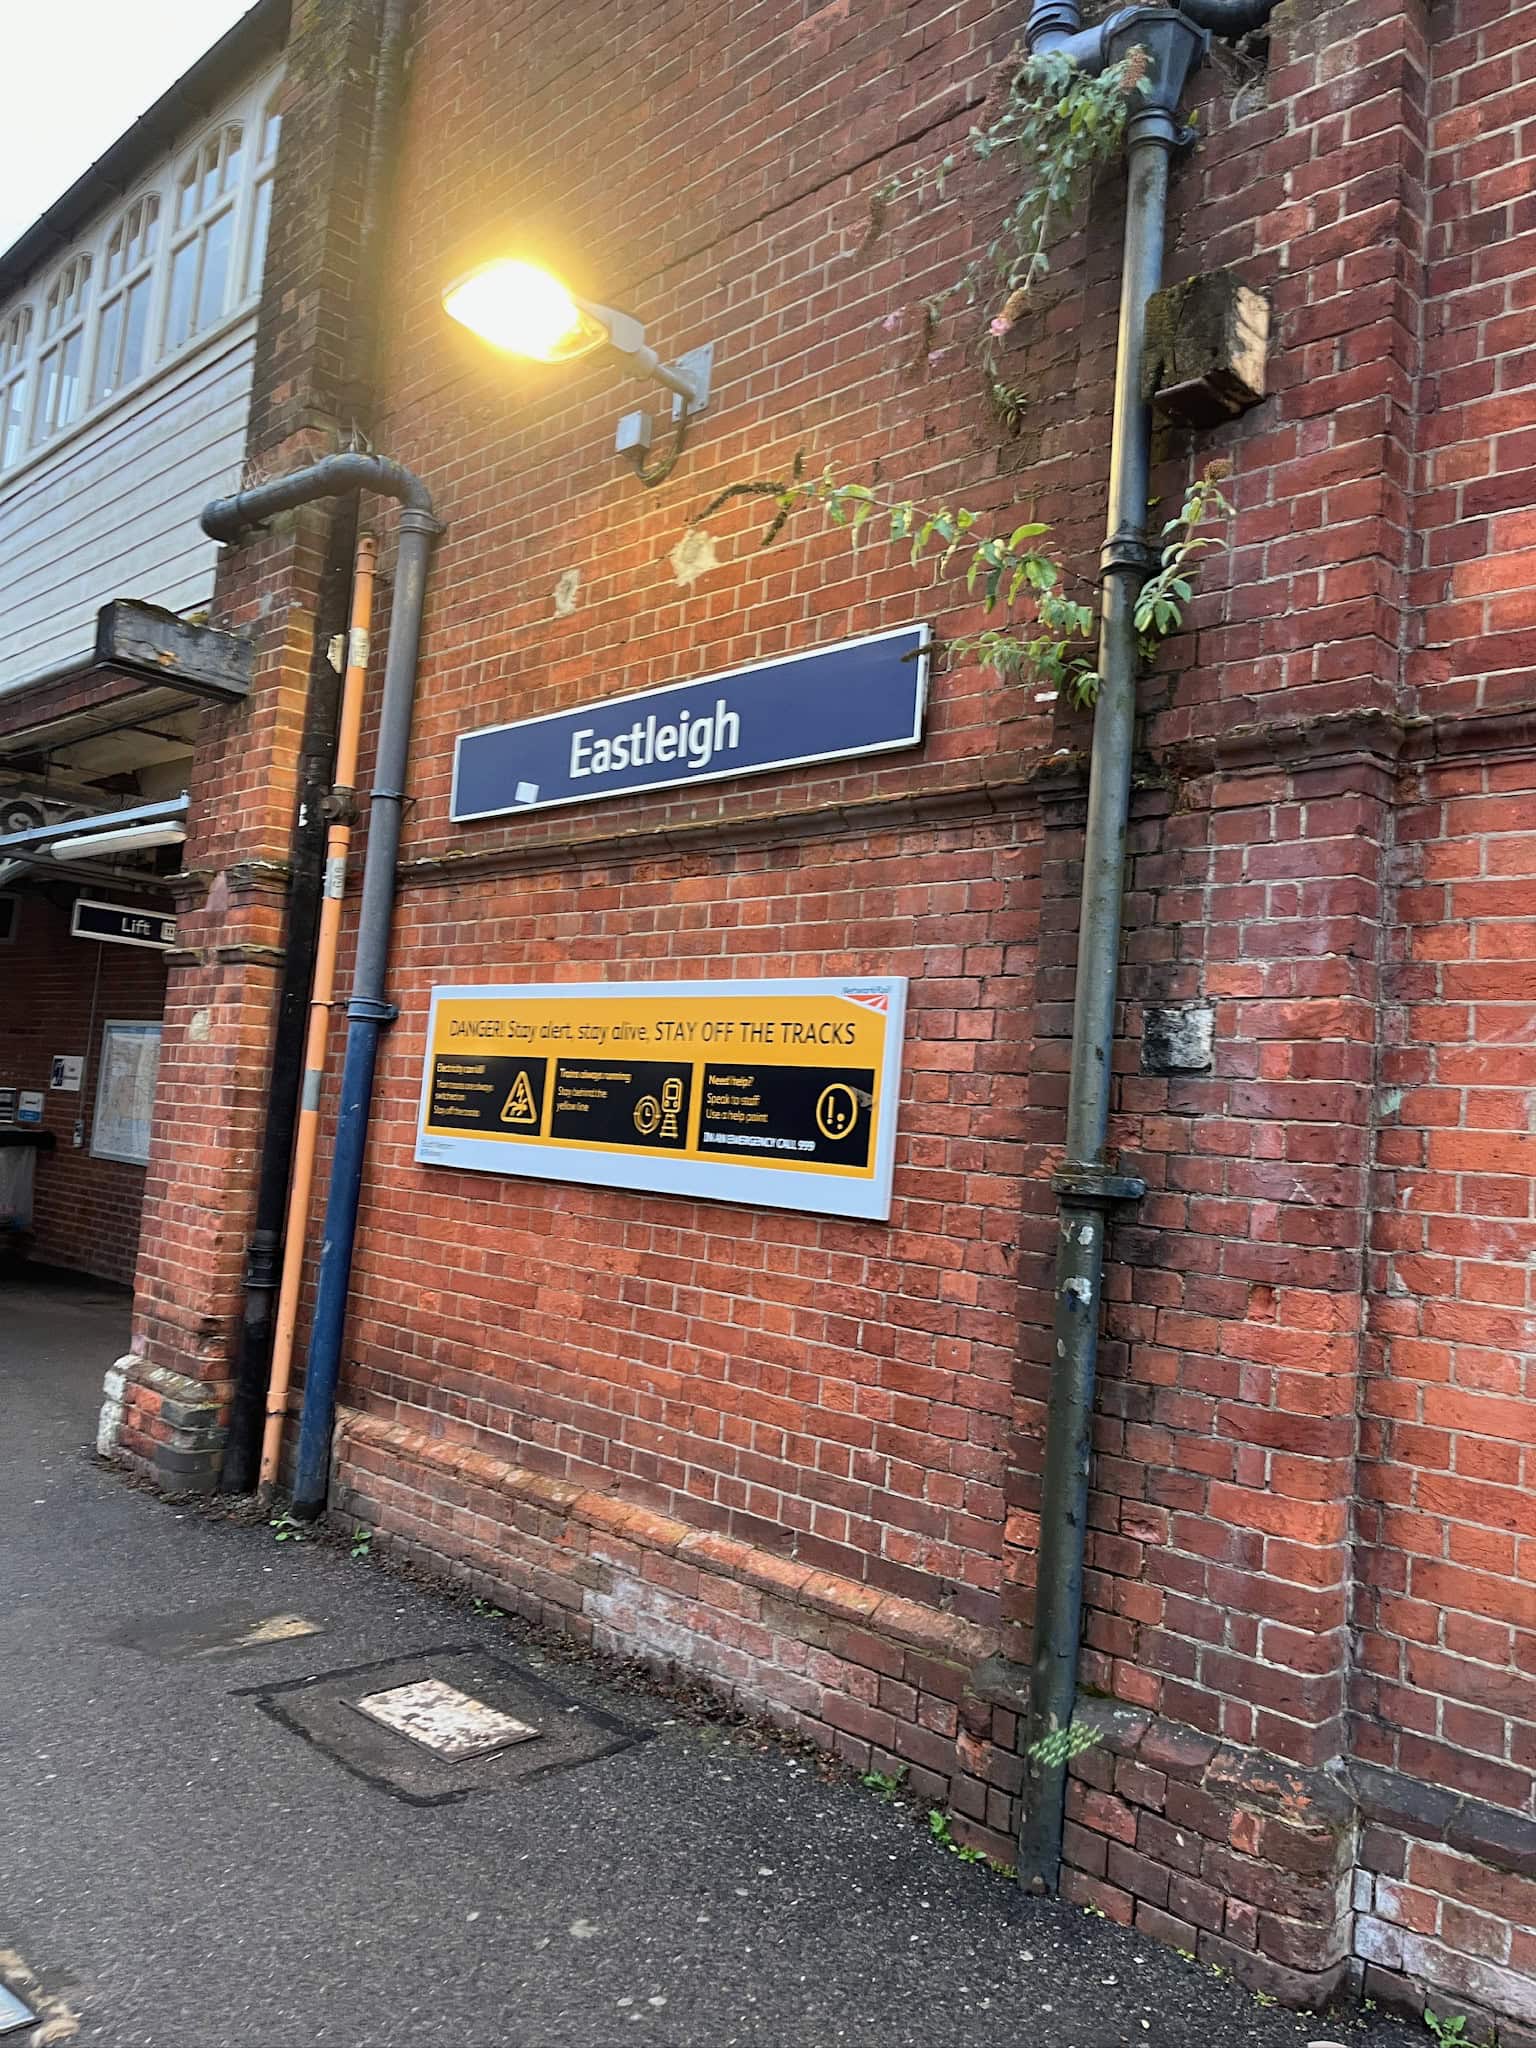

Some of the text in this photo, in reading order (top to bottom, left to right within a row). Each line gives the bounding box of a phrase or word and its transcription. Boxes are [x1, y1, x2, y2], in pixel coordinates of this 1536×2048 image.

[569, 699, 740, 779] Eastleigh
[121, 917, 152, 936] Lift
[450, 1020, 504, 1038] DANGER!
[508, 1020, 535, 1043] Stay
[578, 1021, 609, 1045] stay
[655, 1021, 698, 1041] STAY
[702, 1022, 735, 1042] OFF
[739, 1022, 775, 1043] THE
[780, 1022, 856, 1045] TRACKS
[709, 1074, 755, 1089] Need help?
[707, 1092, 729, 1106] Speak
[705, 1108, 720, 1120] Use
[728, 1110, 744, 1123] help
